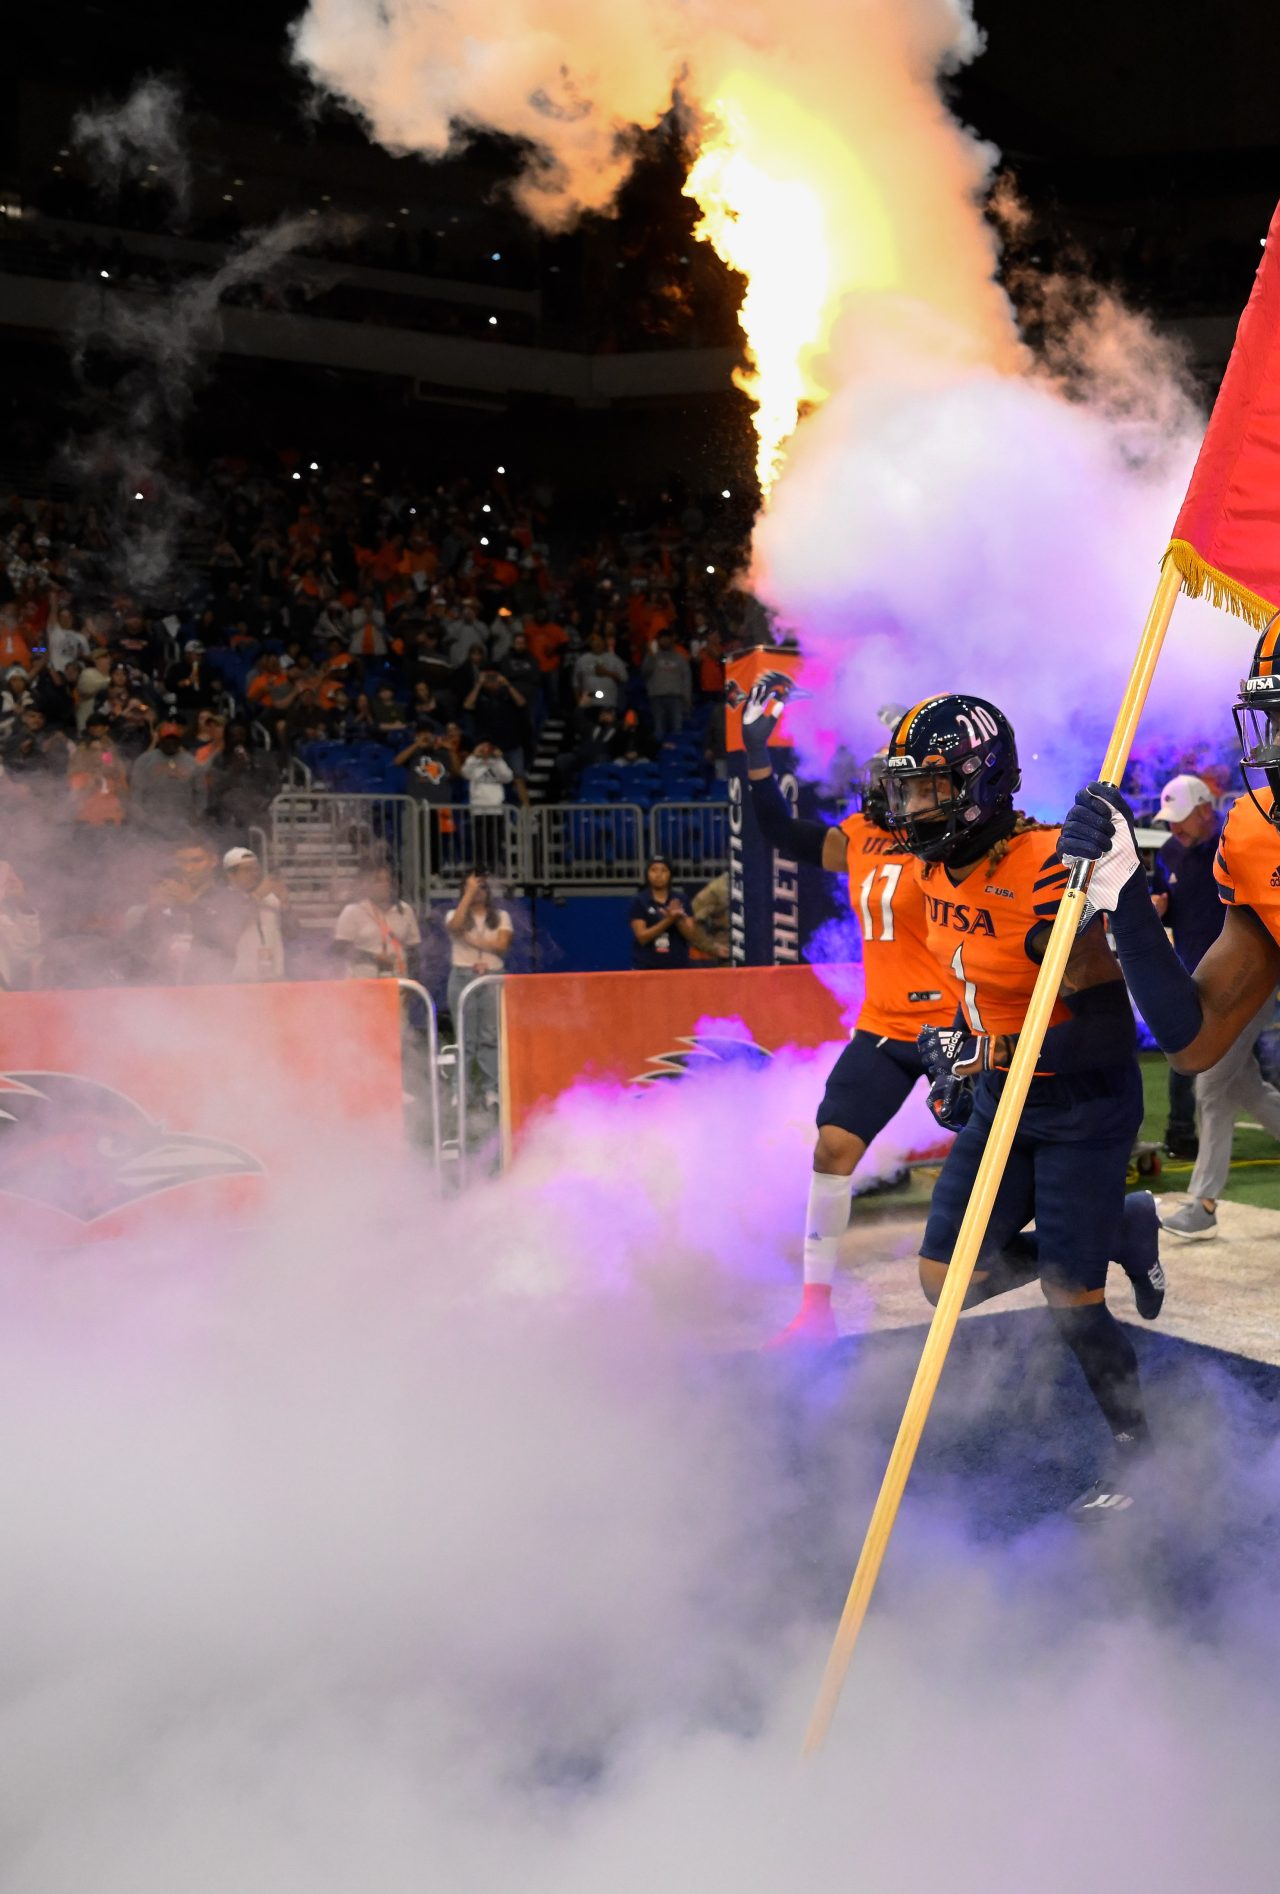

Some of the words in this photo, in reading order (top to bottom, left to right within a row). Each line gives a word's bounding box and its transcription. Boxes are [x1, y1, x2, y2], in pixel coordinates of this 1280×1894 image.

[1246, 676, 1275, 691] UTSA
[955, 705, 999, 749] 210
[860, 863, 903, 942] 17
[925, 894, 997, 938] UTSA
[950, 938, 987, 1033] 1
